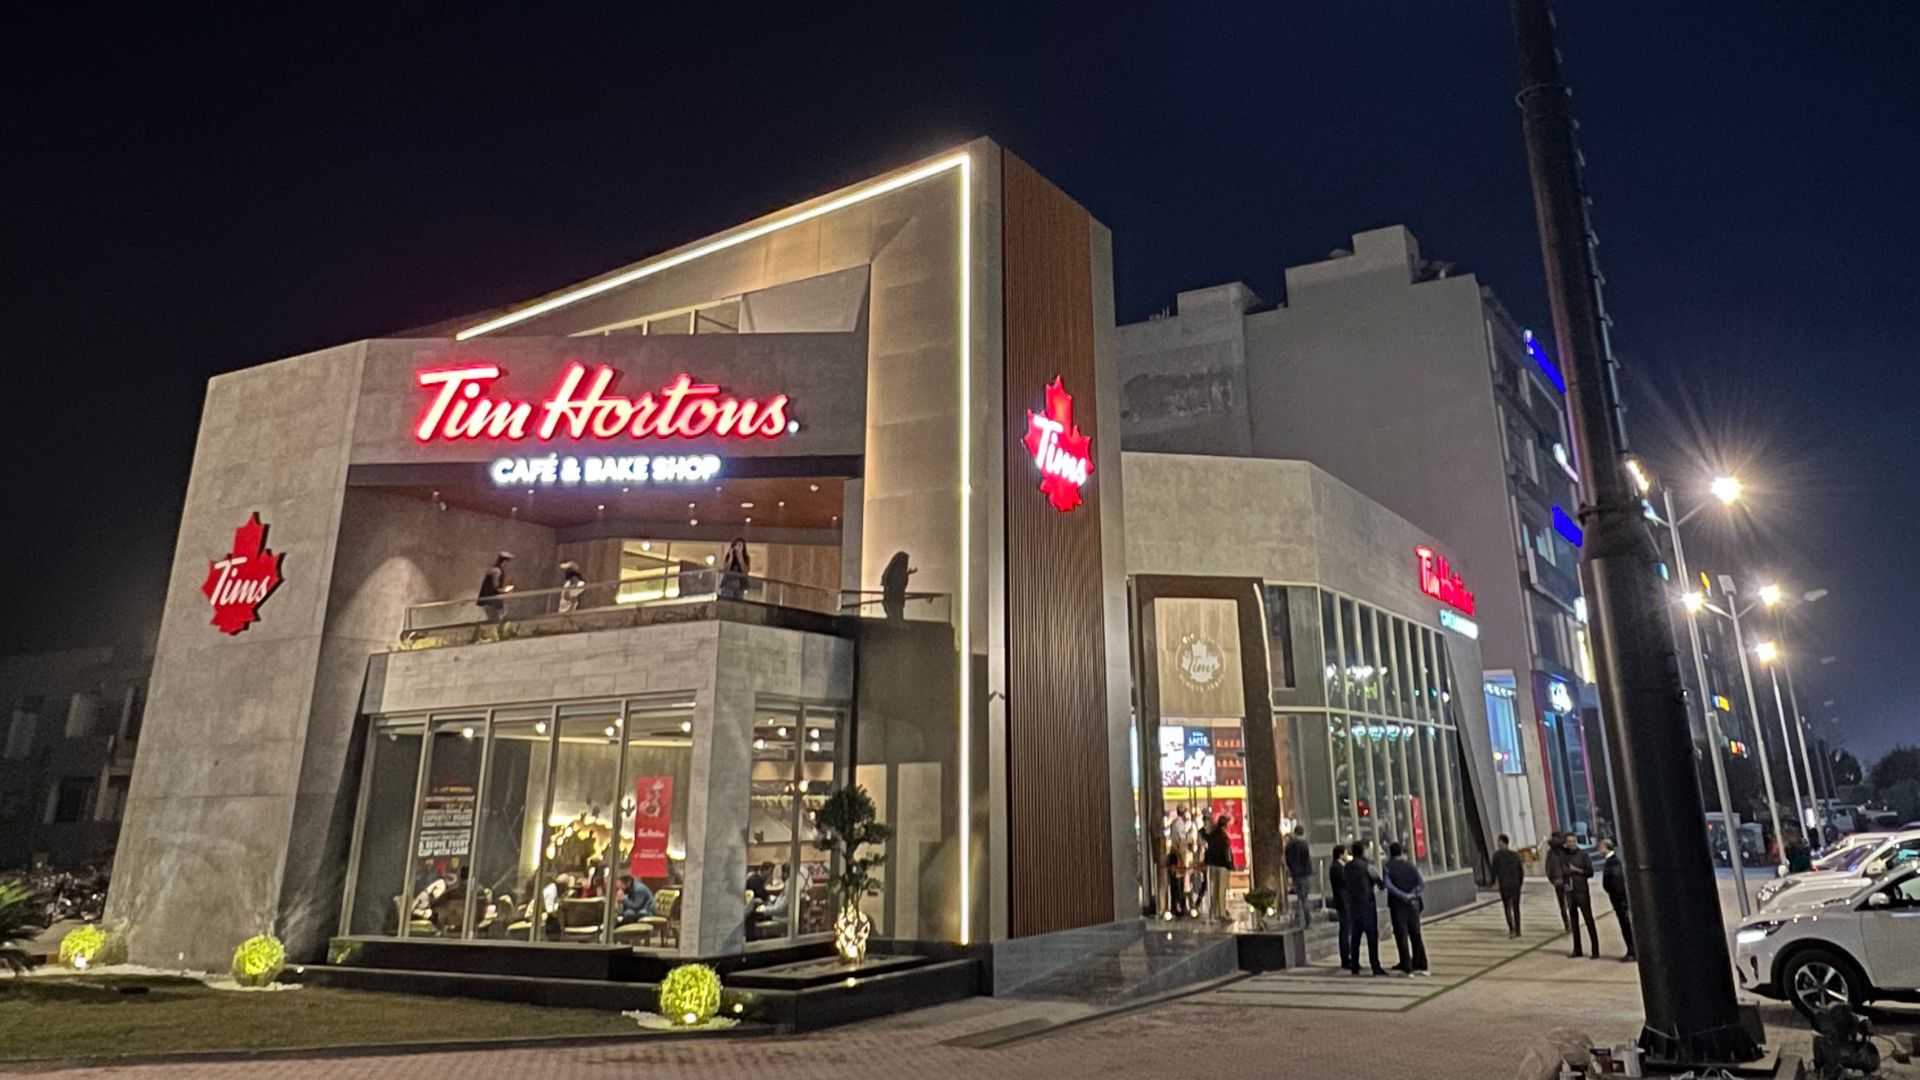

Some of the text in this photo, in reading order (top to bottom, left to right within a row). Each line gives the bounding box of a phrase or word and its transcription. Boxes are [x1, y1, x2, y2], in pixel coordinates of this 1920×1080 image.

[416, 365, 534, 442] Tim
[493, 453, 721, 484] CAFÉ & BAKE SHOP
[1033, 415, 1087, 486] Tims
[210, 556, 271, 607] Tims
